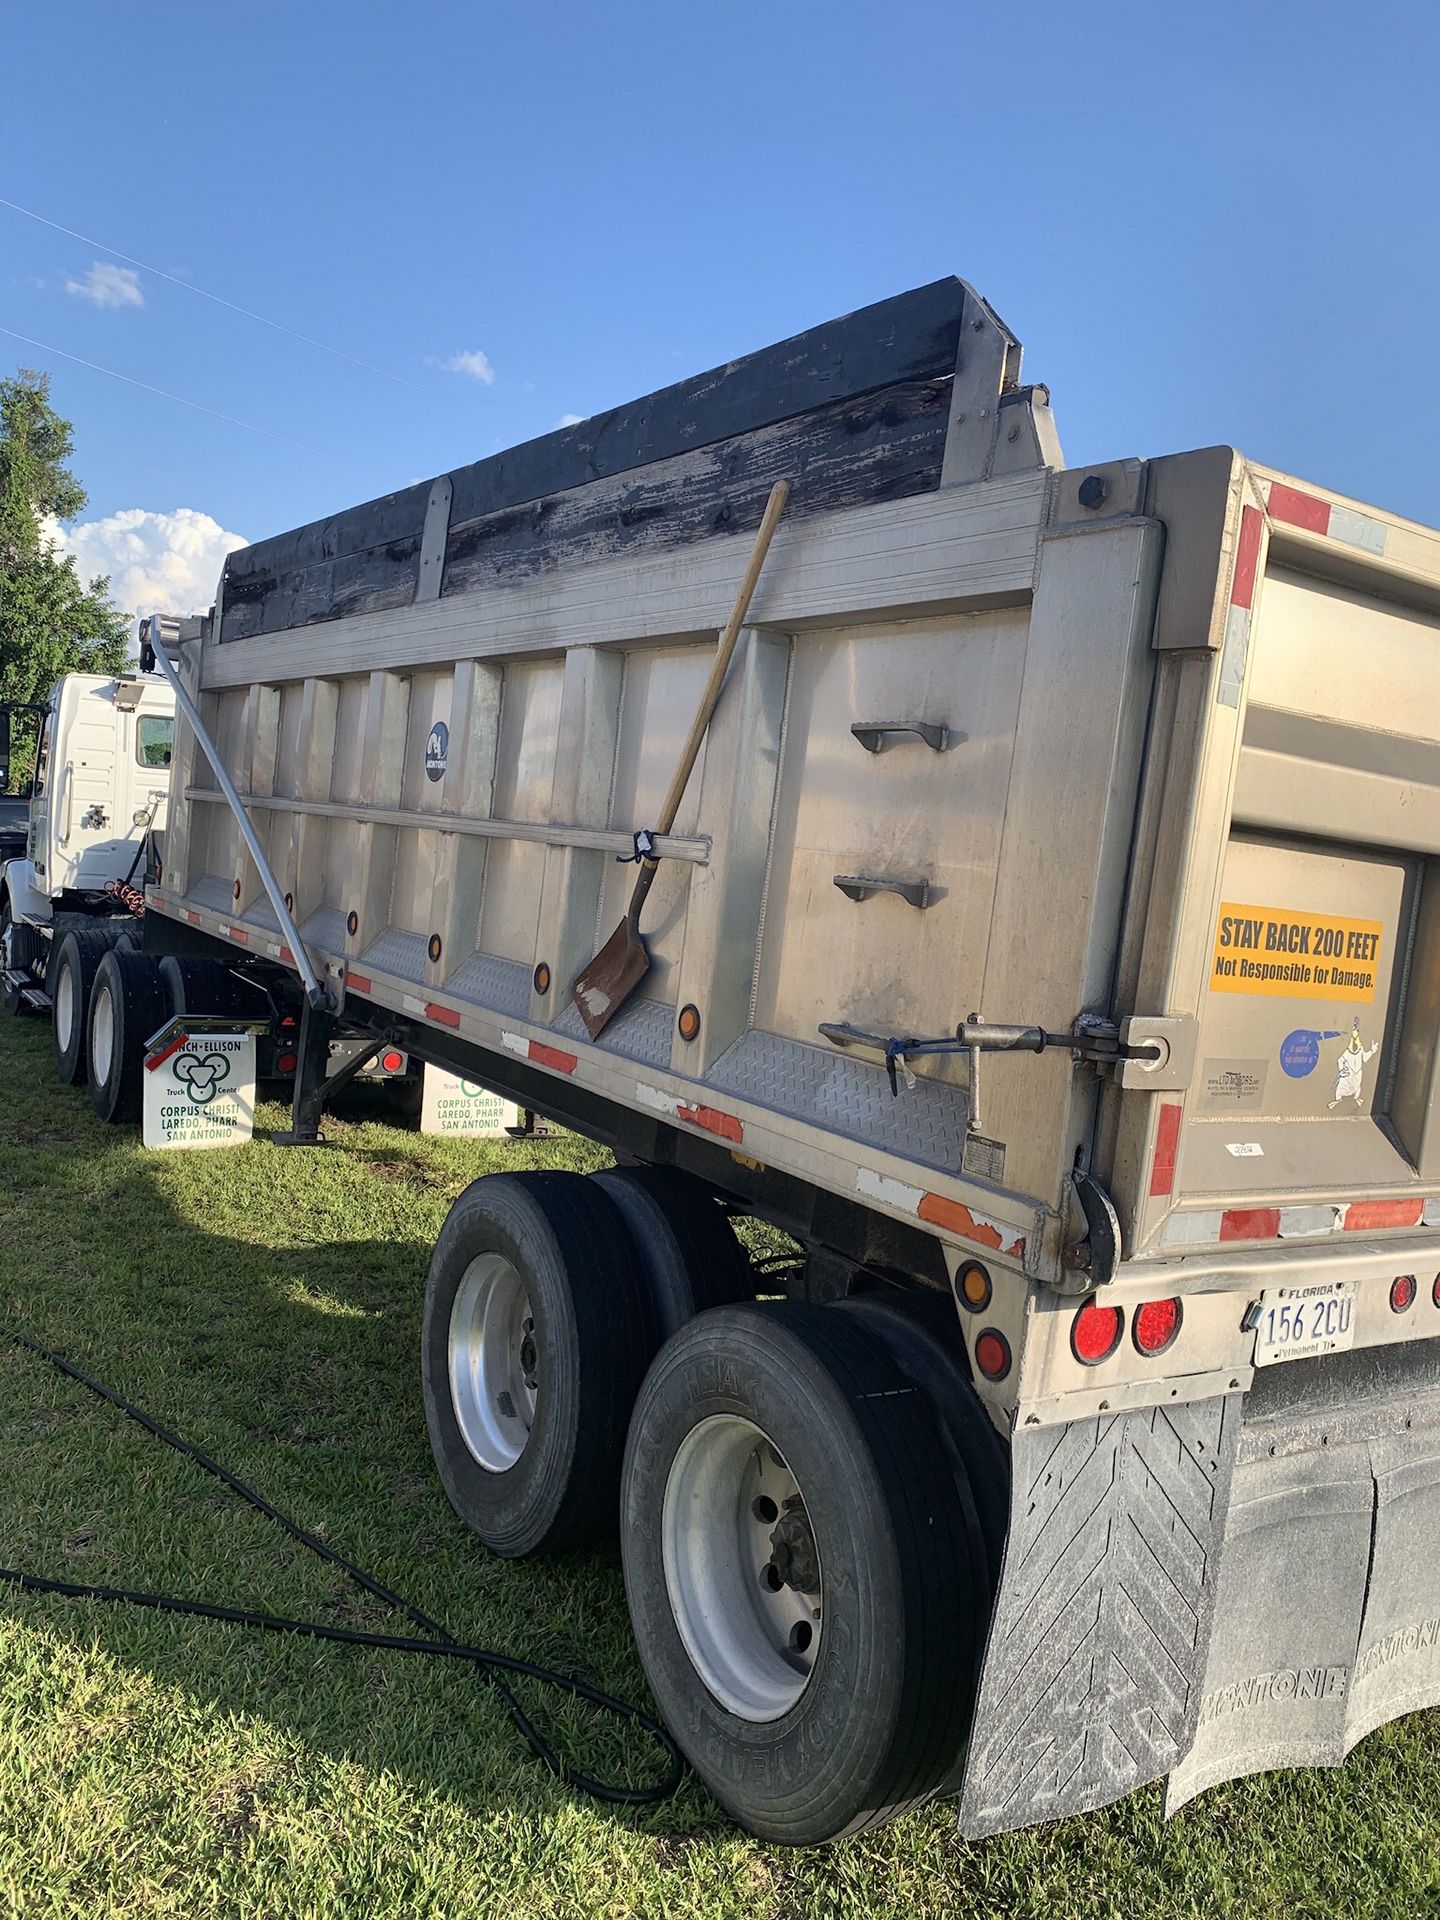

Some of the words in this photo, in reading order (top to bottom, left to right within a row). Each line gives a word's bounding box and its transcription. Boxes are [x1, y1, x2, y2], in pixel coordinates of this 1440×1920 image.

[1220, 917, 1264, 950] STAY
[1265, 922, 1312, 954] BACK
[1312, 927, 1344, 958] 200
[1346, 931, 1379, 961] FEET
[1215, 956, 1237, 977] Not
[1239, 958, 1311, 983] Responsible
[1313, 965, 1329, 985] for
[1331, 967, 1374, 989] Damage.
[167, 1088, 185, 1096] Truck
[437, 1099, 471, 1109] CORPUS
[474, 1098, 505, 1107] CHRISTI
[160, 1105, 199, 1117] CORPUS
[203, 1104, 240, 1116] CHRISTI
[437, 1110, 473, 1120] LAREDO,
[476, 1108, 504, 1117] PHARR
[161, 1117, 202, 1129] LAREDO,
[205, 1116, 238, 1127] PHARR
[441, 1120, 459, 1130] SAN
[462, 1119, 500, 1129] ANTONIO
[166, 1131, 187, 1142] SAN
[190, 1128, 232, 1140] ANTONIO
[1288, 1284, 1334, 1299] FLORIDA
[1265, 1304, 1305, 1347] 156
[1311, 1297, 1353, 1339] 2CU
